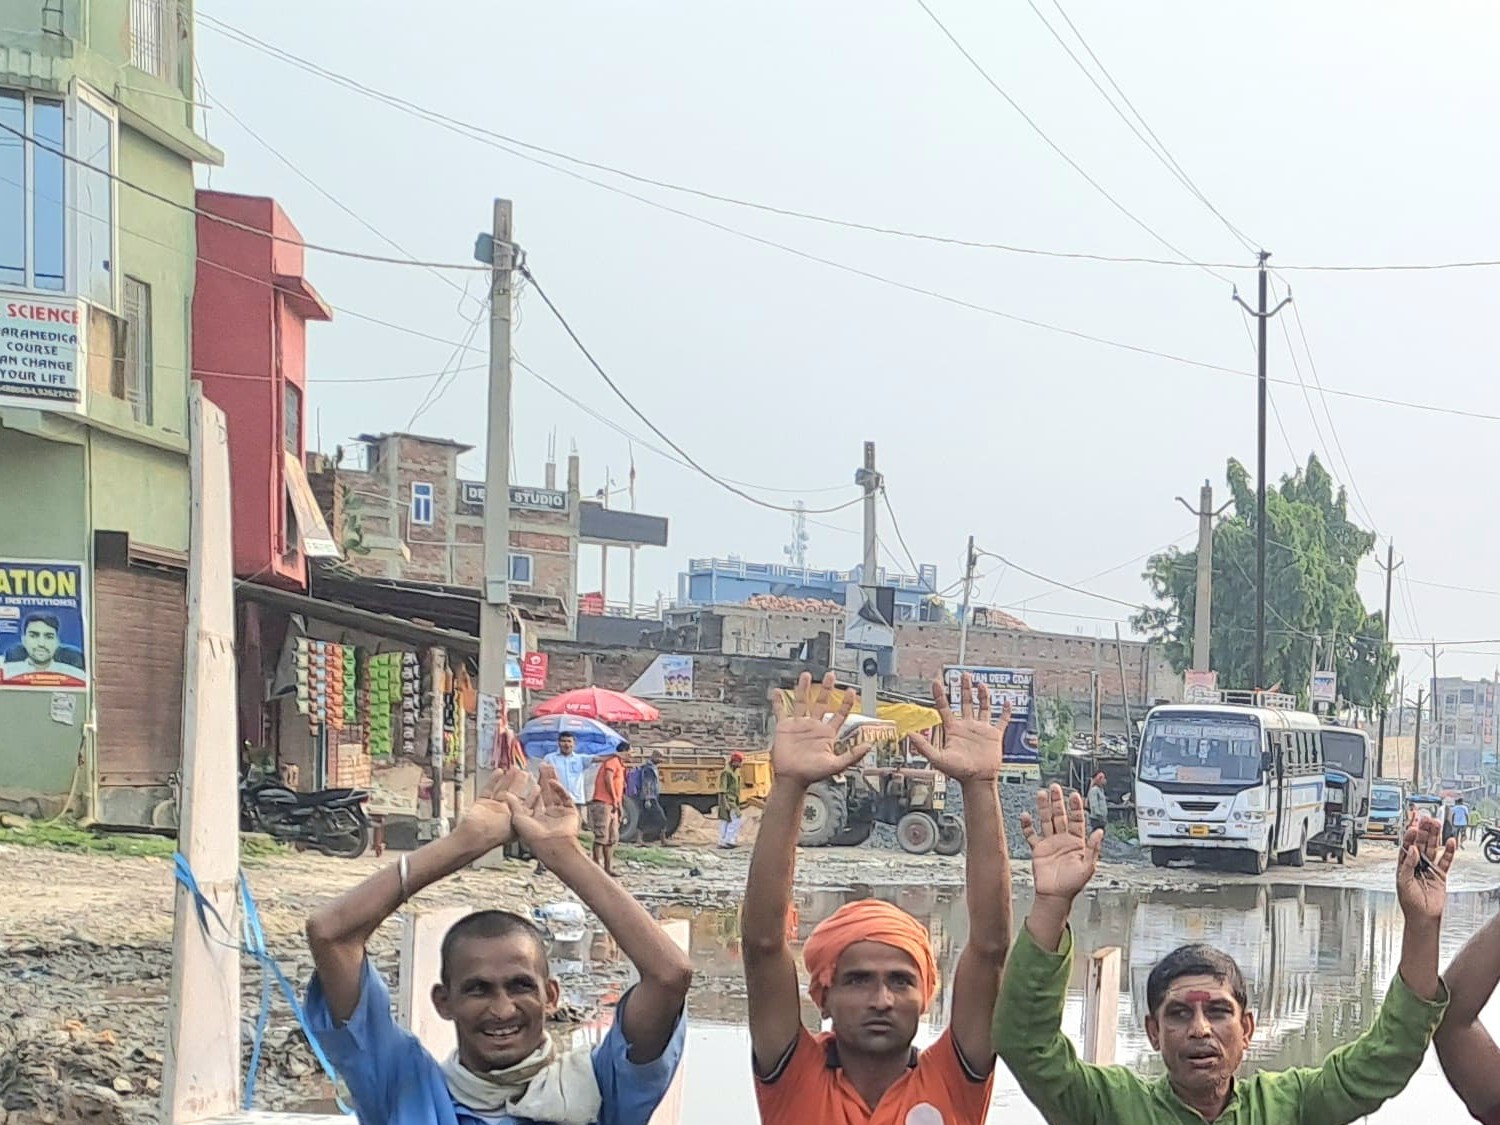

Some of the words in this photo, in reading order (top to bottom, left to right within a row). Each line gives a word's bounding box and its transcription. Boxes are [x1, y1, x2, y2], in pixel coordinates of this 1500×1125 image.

[7, 303, 79, 326] SCIENCE
[6, 341, 59, 356] COURSE
[21, 357, 74, 372] CHANGE
[0, 369, 37, 382] YOUR
[41, 373, 67, 385] LIFE
[468, 487, 486, 499] DE
[514, 491, 563, 507] STUDIO
[0, 569, 77, 598] ATION
